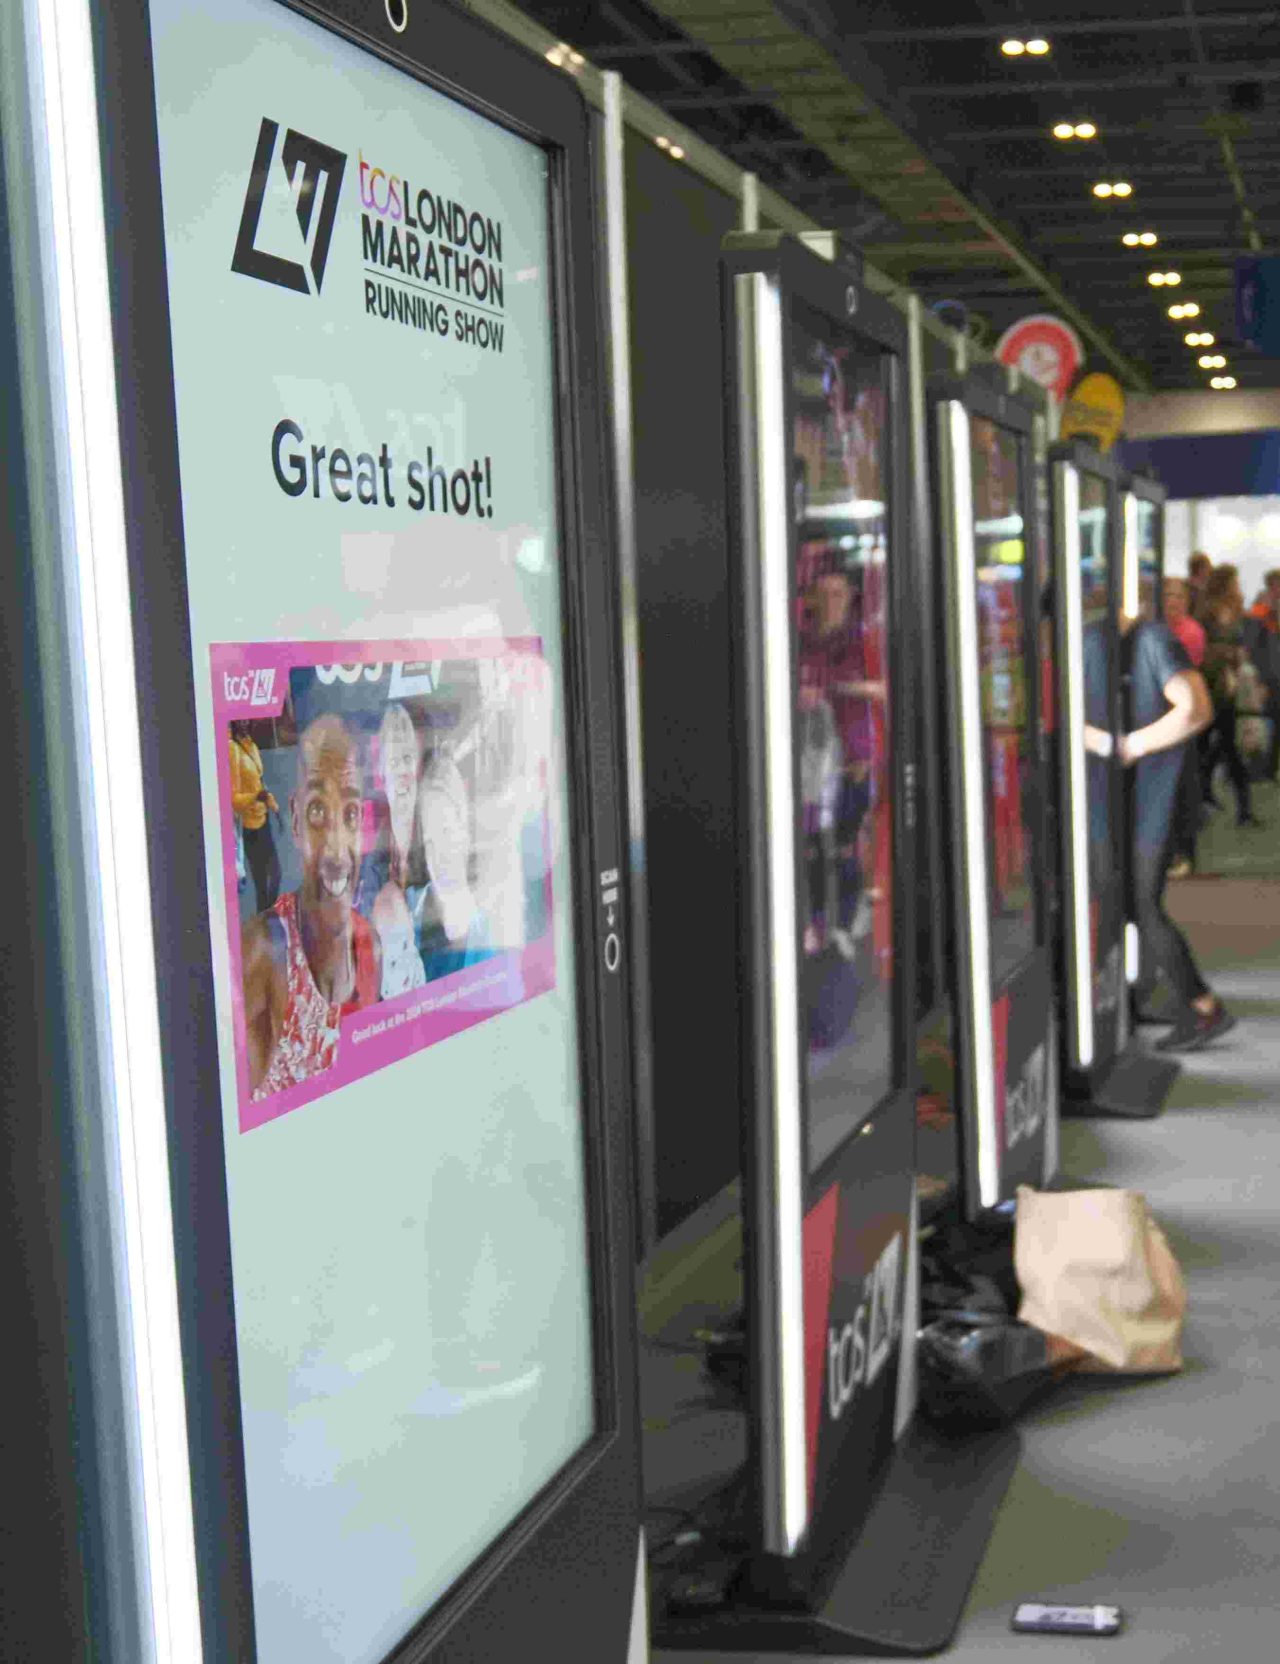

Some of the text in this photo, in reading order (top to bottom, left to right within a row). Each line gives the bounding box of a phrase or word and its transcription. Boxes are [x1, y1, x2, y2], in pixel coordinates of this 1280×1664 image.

[357, 148, 503, 263] tcs LONDON
[361, 213, 504, 309] MARATHON
[364, 279, 505, 354] RUNNING SHOW
[271, 418, 494, 519] Great shot!
[223, 671, 250, 702] tcs
[827, 1302, 866, 1421] tcs
